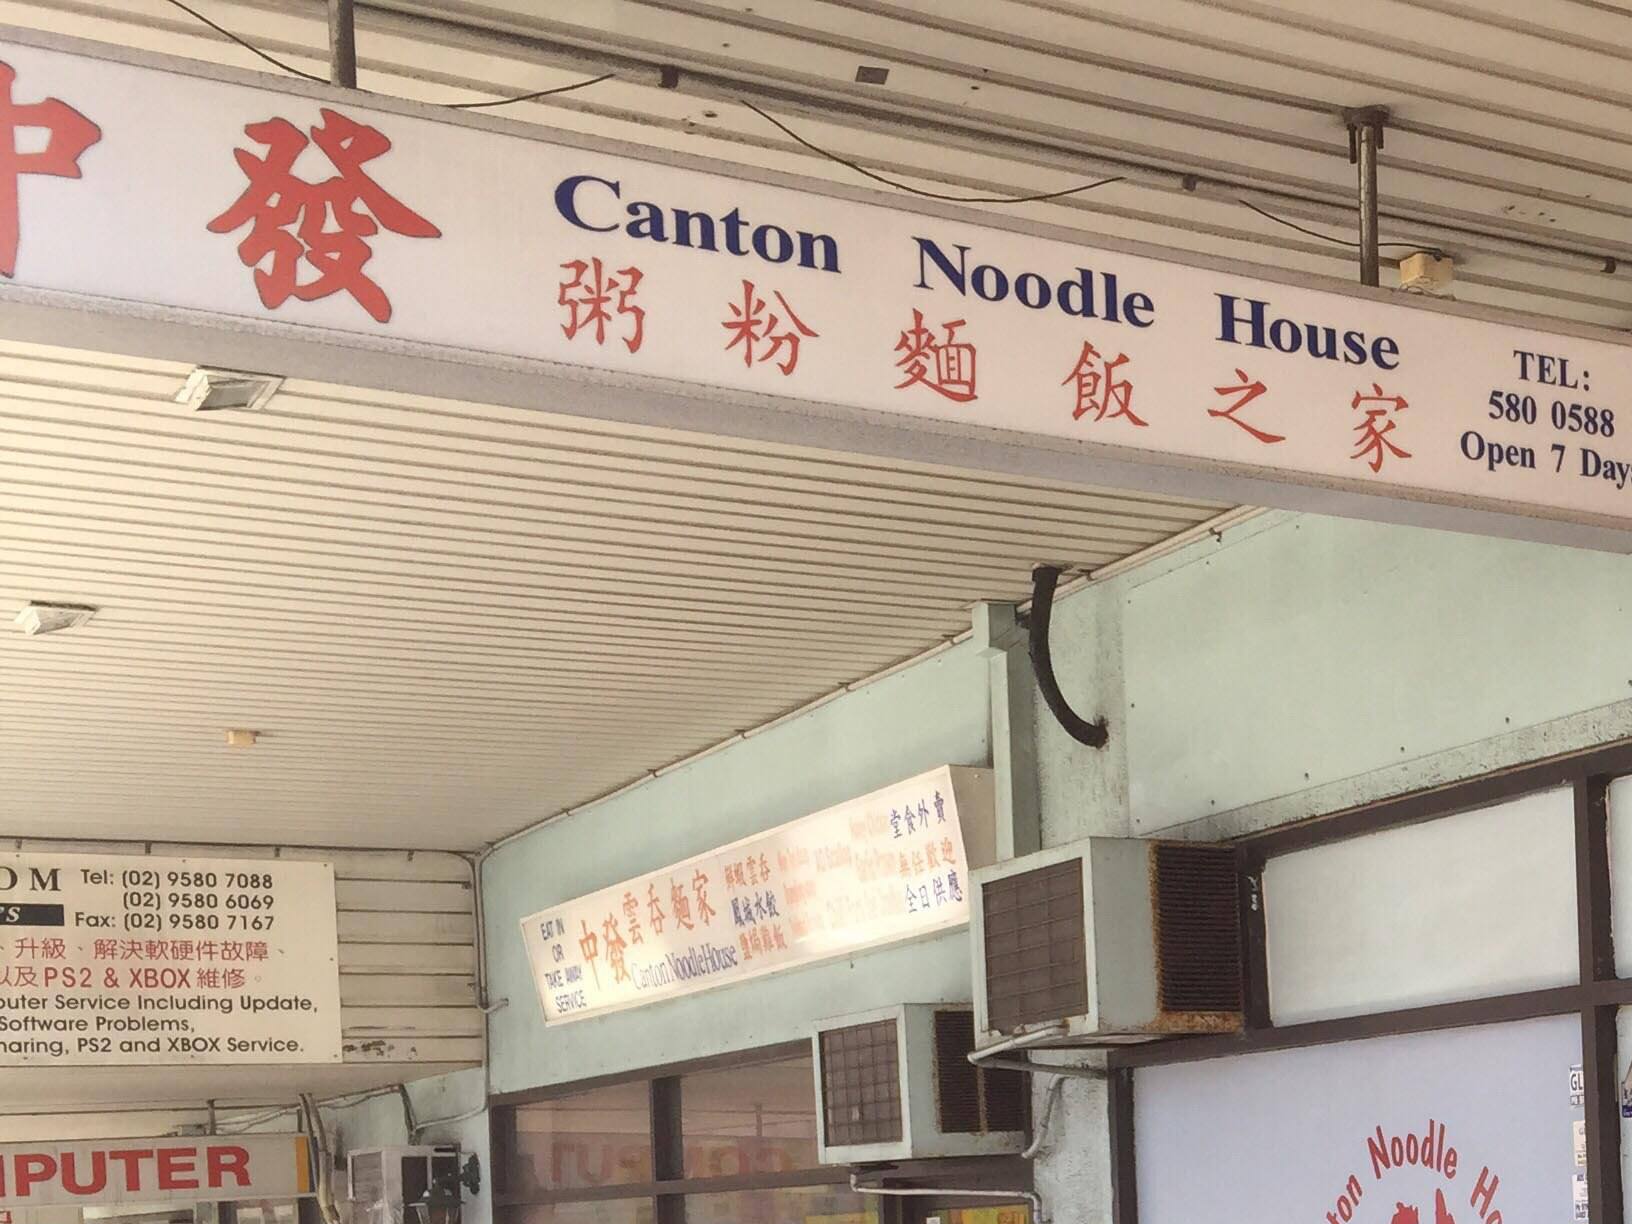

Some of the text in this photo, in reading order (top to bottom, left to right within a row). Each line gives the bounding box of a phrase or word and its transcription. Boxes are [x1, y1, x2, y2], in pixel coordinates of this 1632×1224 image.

[0, 61, 441, 324] 中發
[554, 175, 1400, 371] Canton Noodle House
[558, 257, 1412, 473] 粥粉麵飯之家
[1513, 350, 1590, 391] TEL:
[1489, 390, 1615, 438] 580 0588
[1460, 431, 1536, 472] Open
[1551, 443, 1566, 473] 7
[890, 790, 946, 839] 堂食外賣
[81, 869, 273, 889] Tel: (02) 9580 7088
[906, 869, 963, 913] 全日供應
[75, 911, 274, 932] Fax: (02) 9580 7167
[123, 891, 274, 911] (02) 9580 6069
[540, 921, 554, 940] EAT
[579, 868, 716, 990] 中發雲吞麵家
[552, 943, 565, 963] OR
[631, 942, 739, 990] Canton Noodle House
[44, 967, 92, 988] PS2
[103, 967, 120, 988] &
[129, 967, 191, 989] XBOX
[544, 970, 564, 989] TAKE
[55, 994, 130, 1010] Service
[137, 994, 233, 1014] Including
[240, 995, 318, 1013] Update,
[555, 990, 587, 1013] SERVICE
[0, 1016, 195, 1033] Software Problems,
[77, 1037, 112, 1053] PS2
[119, 1037, 160, 1053] and
[167, 1037, 220, 1053] XBOX
[227, 1037, 304, 1053] Service.
[1368, 1118, 1458, 1179] Noodle
[0, 1146, 251, 1197] PUTER
